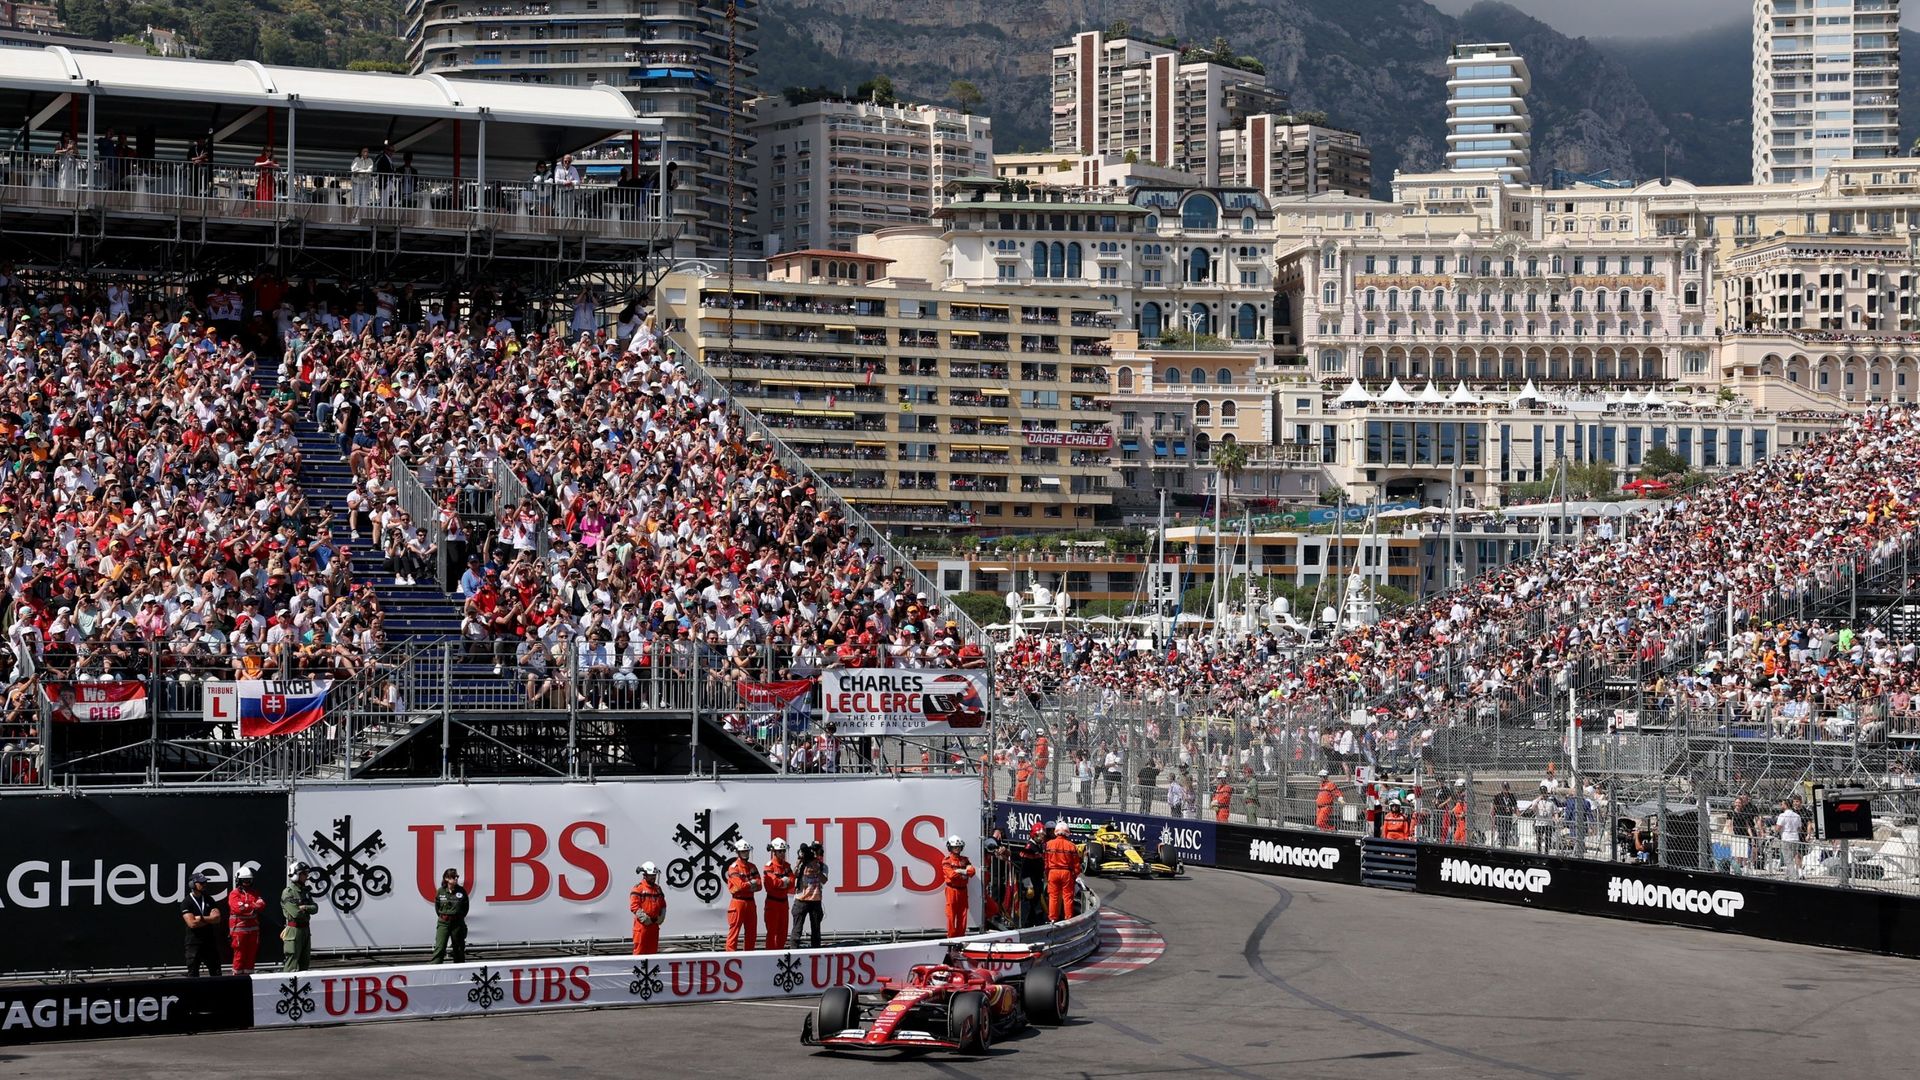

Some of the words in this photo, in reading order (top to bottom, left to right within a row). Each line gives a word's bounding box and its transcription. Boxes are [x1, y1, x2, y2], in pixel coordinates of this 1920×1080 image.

[1028, 433, 1063, 444] DAGHE
[1065, 434, 1108, 445] CHARLIE
[83, 687, 106, 702] We
[207, 686, 234, 695] TRIBUNE
[839, 675, 923, 692] CHARLES
[89, 705, 121, 721] CL16
[213, 696, 227, 718] L
[825, 692, 921, 713] LECLERC
[1174, 828, 1202, 850] MSC
[408, 821, 609, 902] UBS
[0, 858, 262, 909] GHeuer
[669, 958, 744, 996] UBS
[809, 951, 877, 989] UBS
[321, 975, 409, 1016] UBS
[509, 965, 591, 1005] UBS
